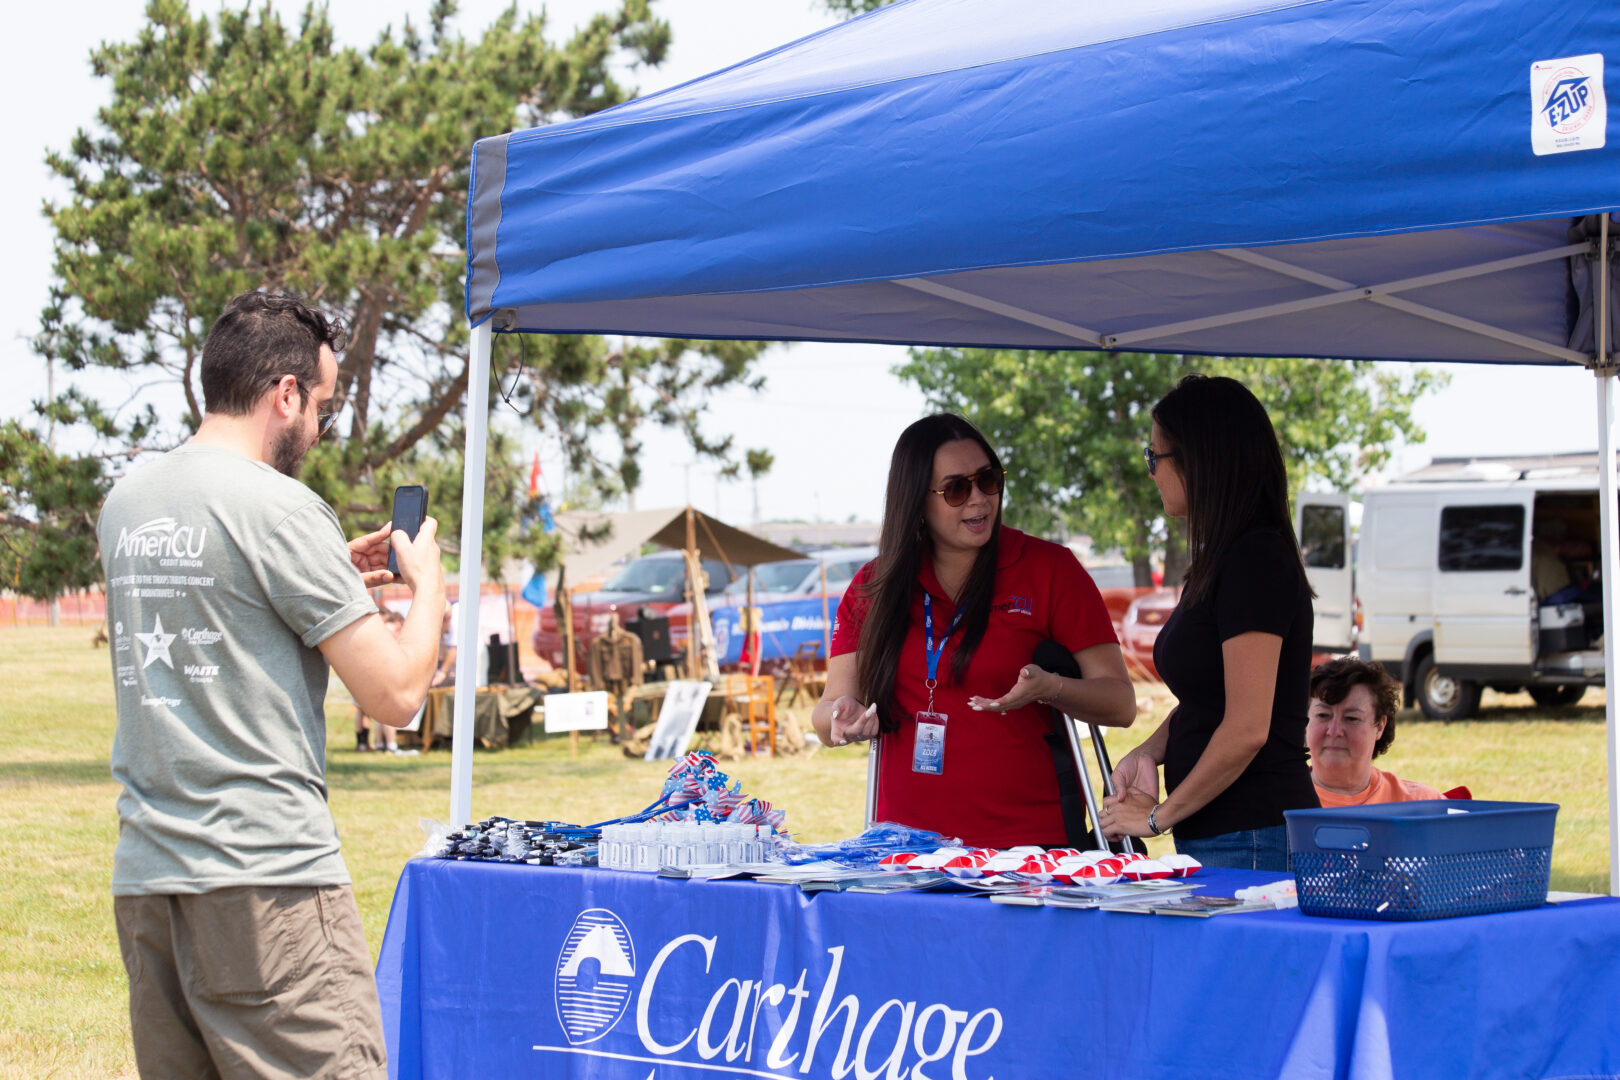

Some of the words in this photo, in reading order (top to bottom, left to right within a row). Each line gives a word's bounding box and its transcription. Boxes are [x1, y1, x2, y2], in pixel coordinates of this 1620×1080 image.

[114, 526, 207, 559] AmeriCU
[180, 558, 203, 568] UNION
[187, 576, 215, 587] CONCERT
[636, 933, 1003, 1080] Carthage
